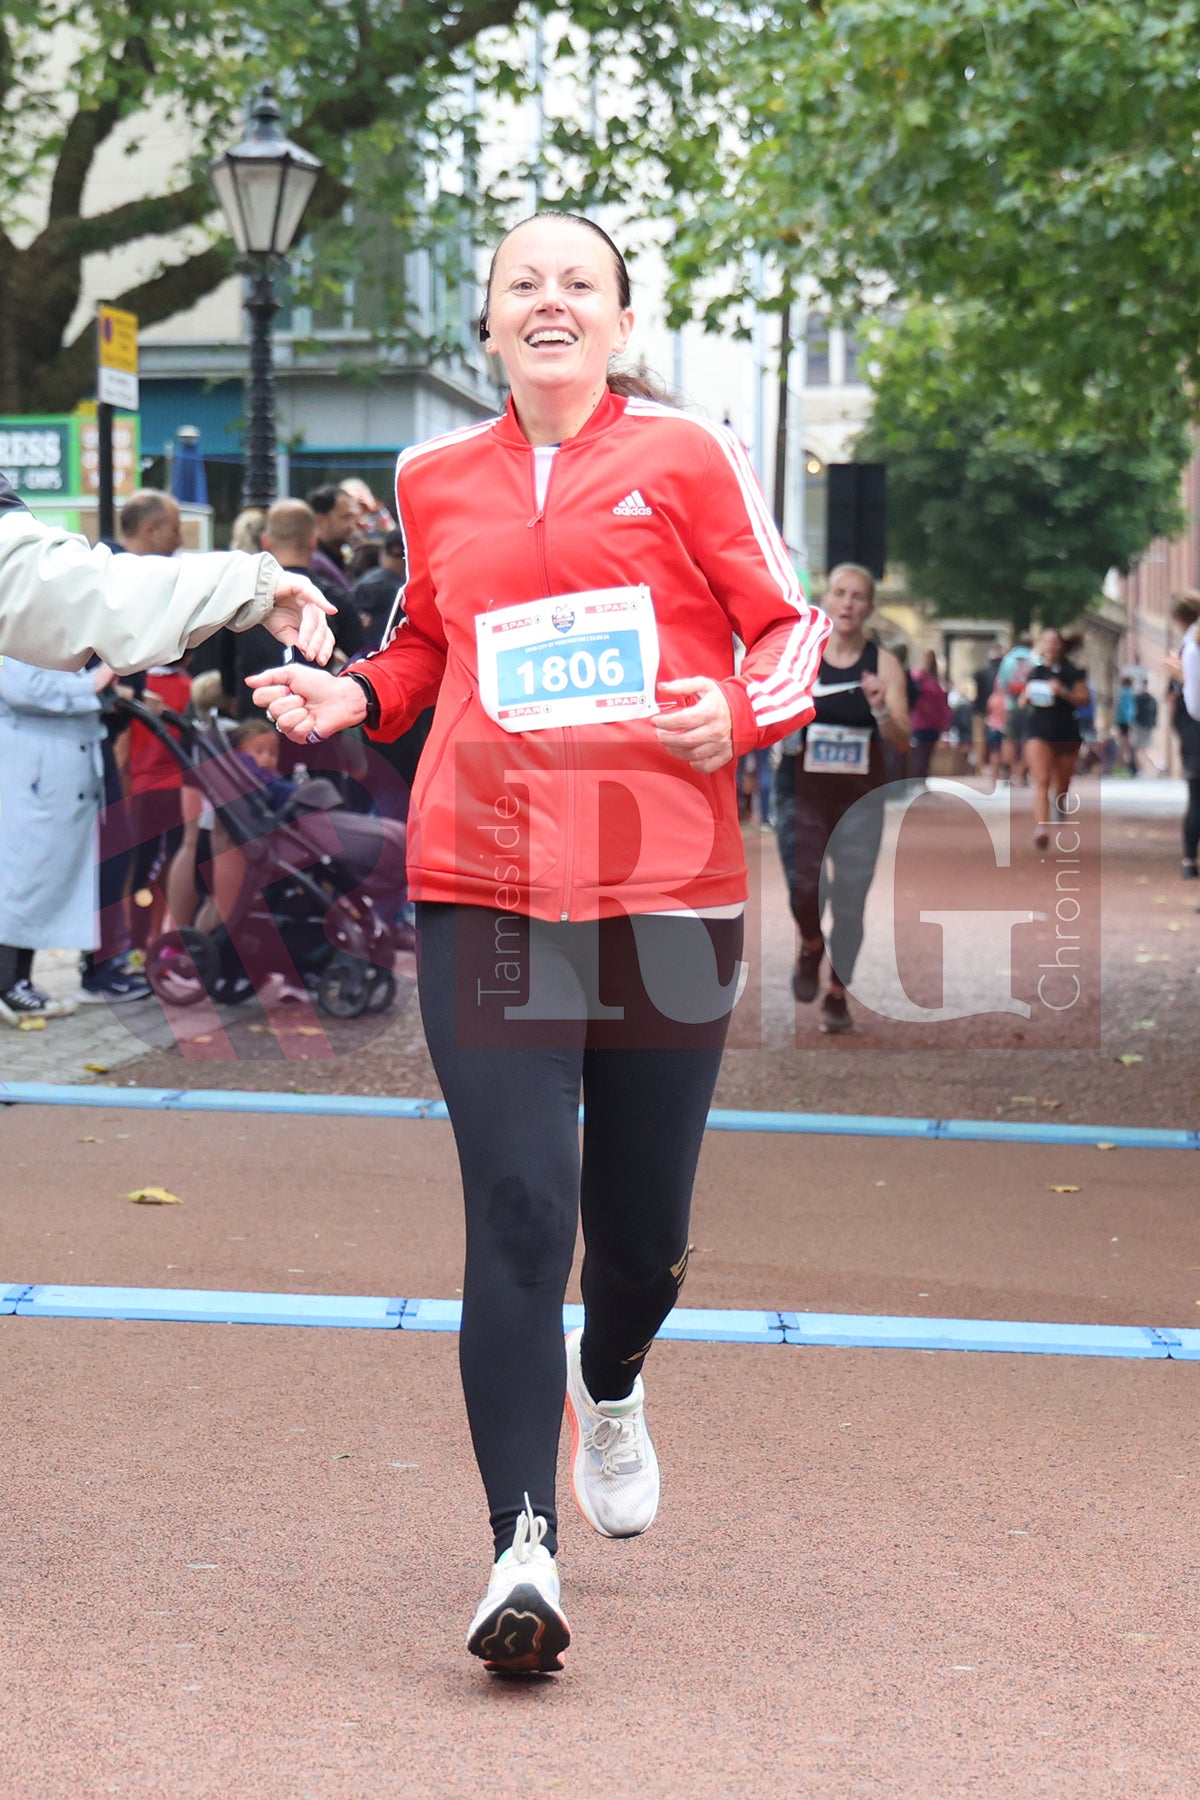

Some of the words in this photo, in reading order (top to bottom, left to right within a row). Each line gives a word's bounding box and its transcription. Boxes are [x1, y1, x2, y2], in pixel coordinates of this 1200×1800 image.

[612, 504, 653, 516] adidas
[595, 602, 628, 613] SPAR
[501, 617, 532, 632] SPAR
[516, 648, 625, 695] 1806
[606, 696, 638, 707] SPAR
[508, 706, 542, 718] SPAR
